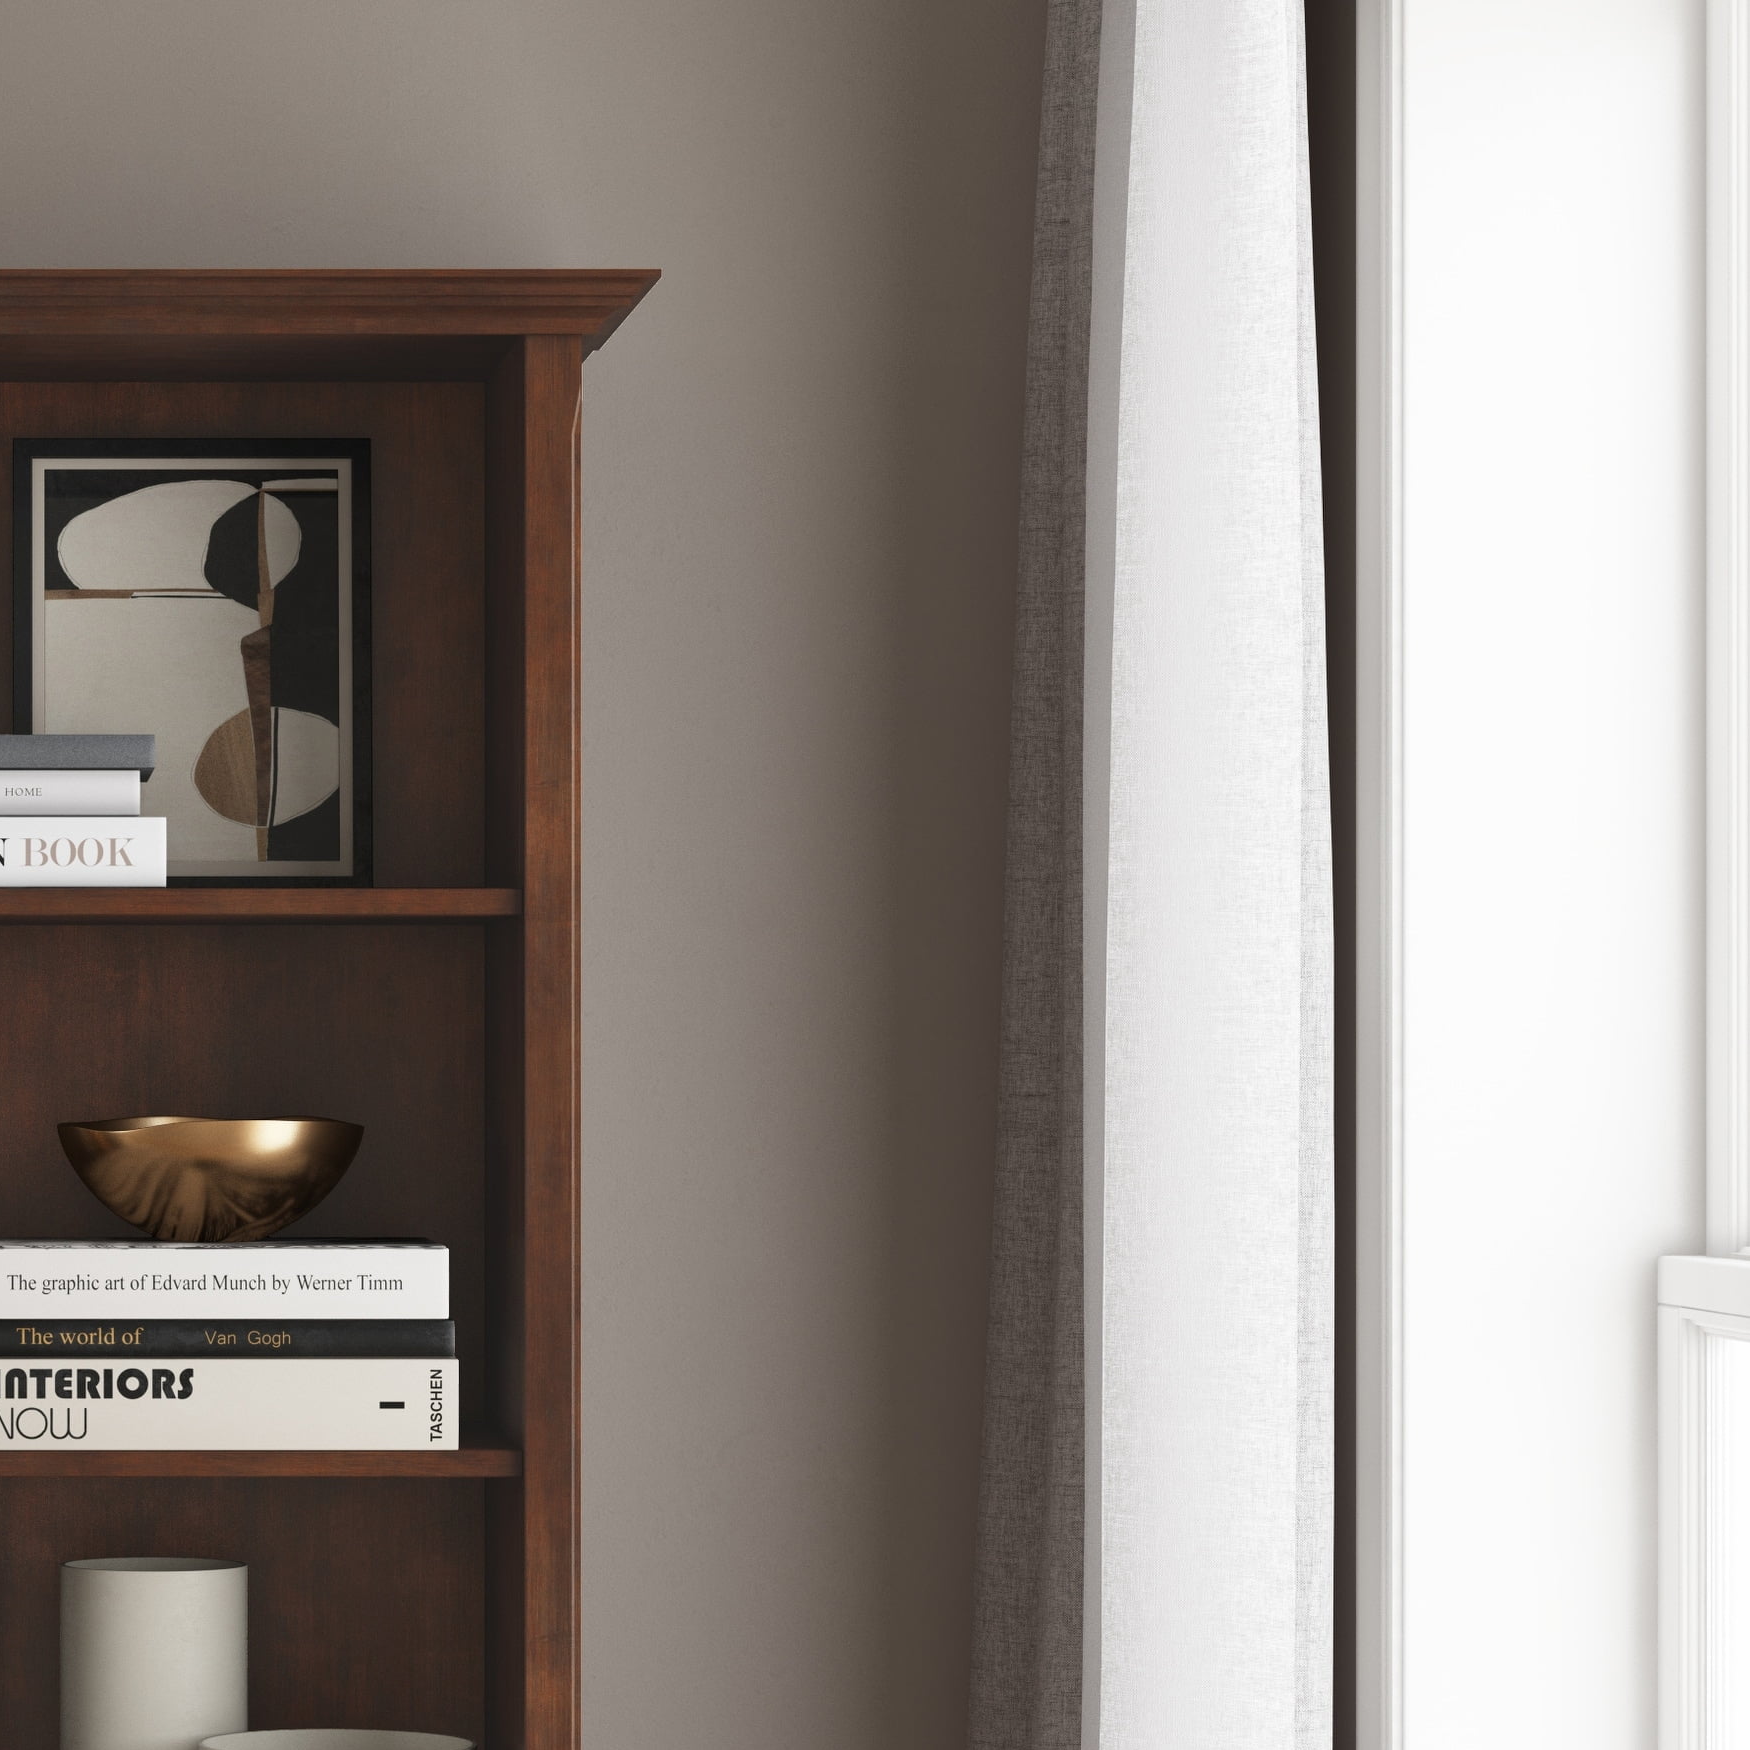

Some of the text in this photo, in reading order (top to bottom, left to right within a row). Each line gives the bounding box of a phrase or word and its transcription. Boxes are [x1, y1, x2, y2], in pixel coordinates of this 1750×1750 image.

[5, 787, 42, 796] HOME
[23, 838, 133, 866] BOOK
[7, 1274, 402, 1295] The graphic art of Edvard Munch by Werner Timm
[17, 1327, 290, 1348] The world of Van Gogh
[430, 1370, 442, 1442] TASCHEN
